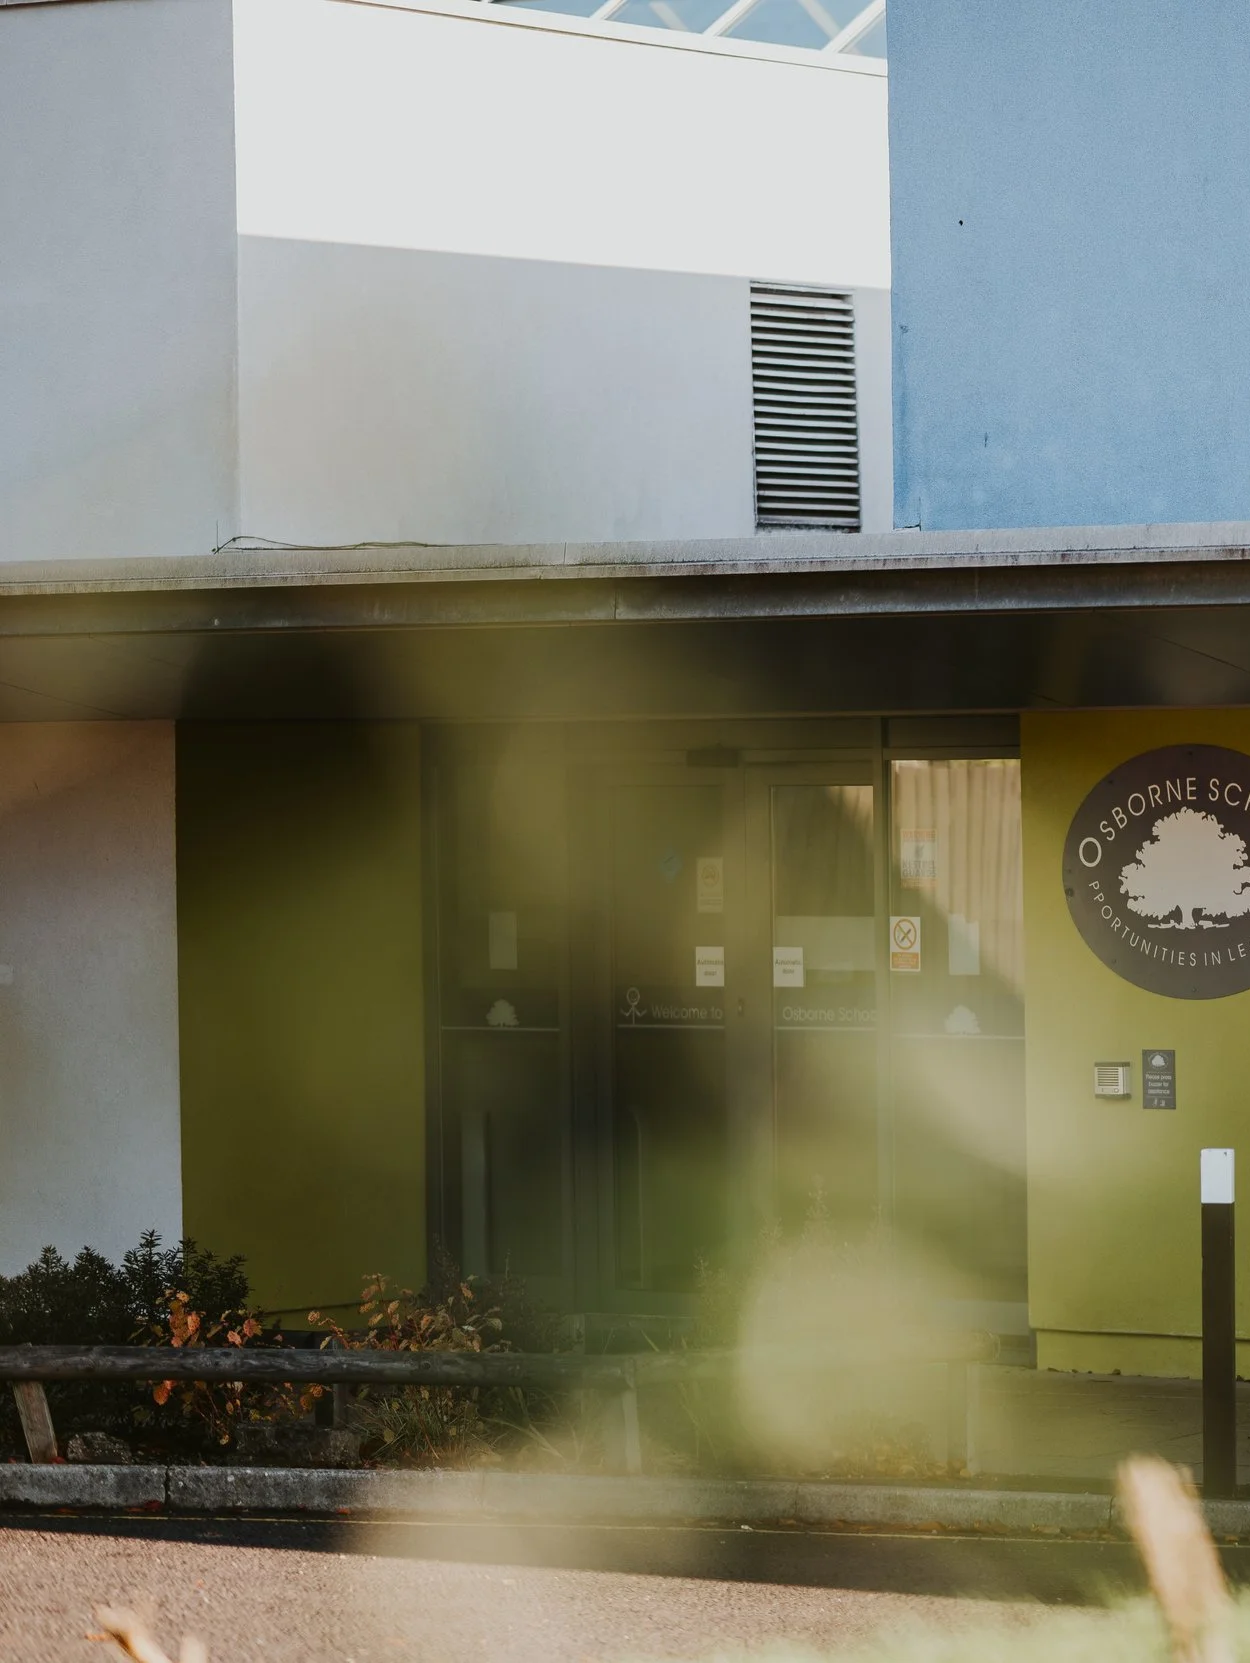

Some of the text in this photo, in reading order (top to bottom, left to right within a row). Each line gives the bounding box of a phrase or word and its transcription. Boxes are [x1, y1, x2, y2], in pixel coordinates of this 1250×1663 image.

[1079, 777, 1197, 867] OSBORNE
[1204, 951, 1221, 967] IN
[651, 1004, 723, 1020] Welcome to
[782, 1006, 835, 1022] Osborne
